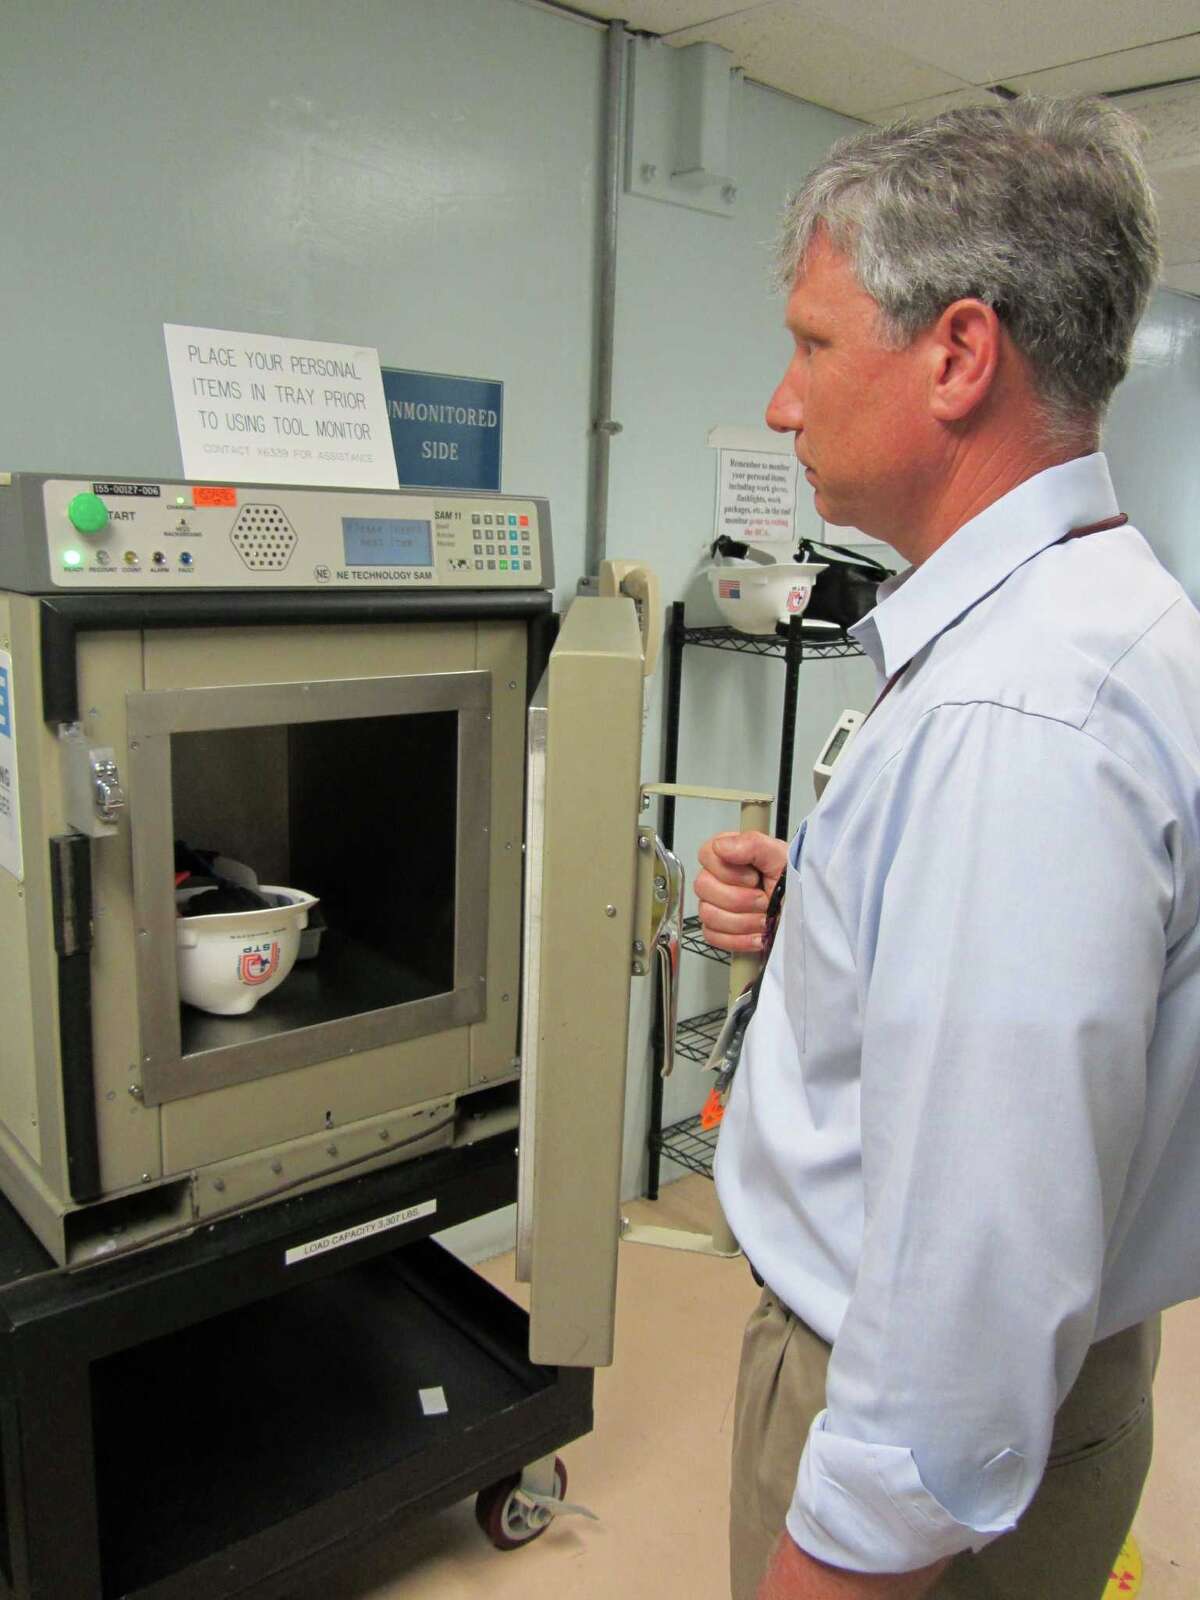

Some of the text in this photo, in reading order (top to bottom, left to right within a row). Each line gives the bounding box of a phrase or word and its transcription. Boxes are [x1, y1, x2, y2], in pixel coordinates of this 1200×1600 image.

[188, 345, 362, 380] PLACE YOUR PERSONAL
[192, 377, 367, 410] ITEMS IN TRAY PRIOR
[198, 410, 372, 440] TO USING TOOL MONITOR
[422, 441, 459, 461] SIDE
[107, 511, 136, 521] TART
[434, 511, 452, 520] SAM
[336, 570, 433, 580] NE TECHNOLOGY SAM
[304, 1239, 330, 1255] LOAD
[331, 1223, 377, 1243] CAPACITY
